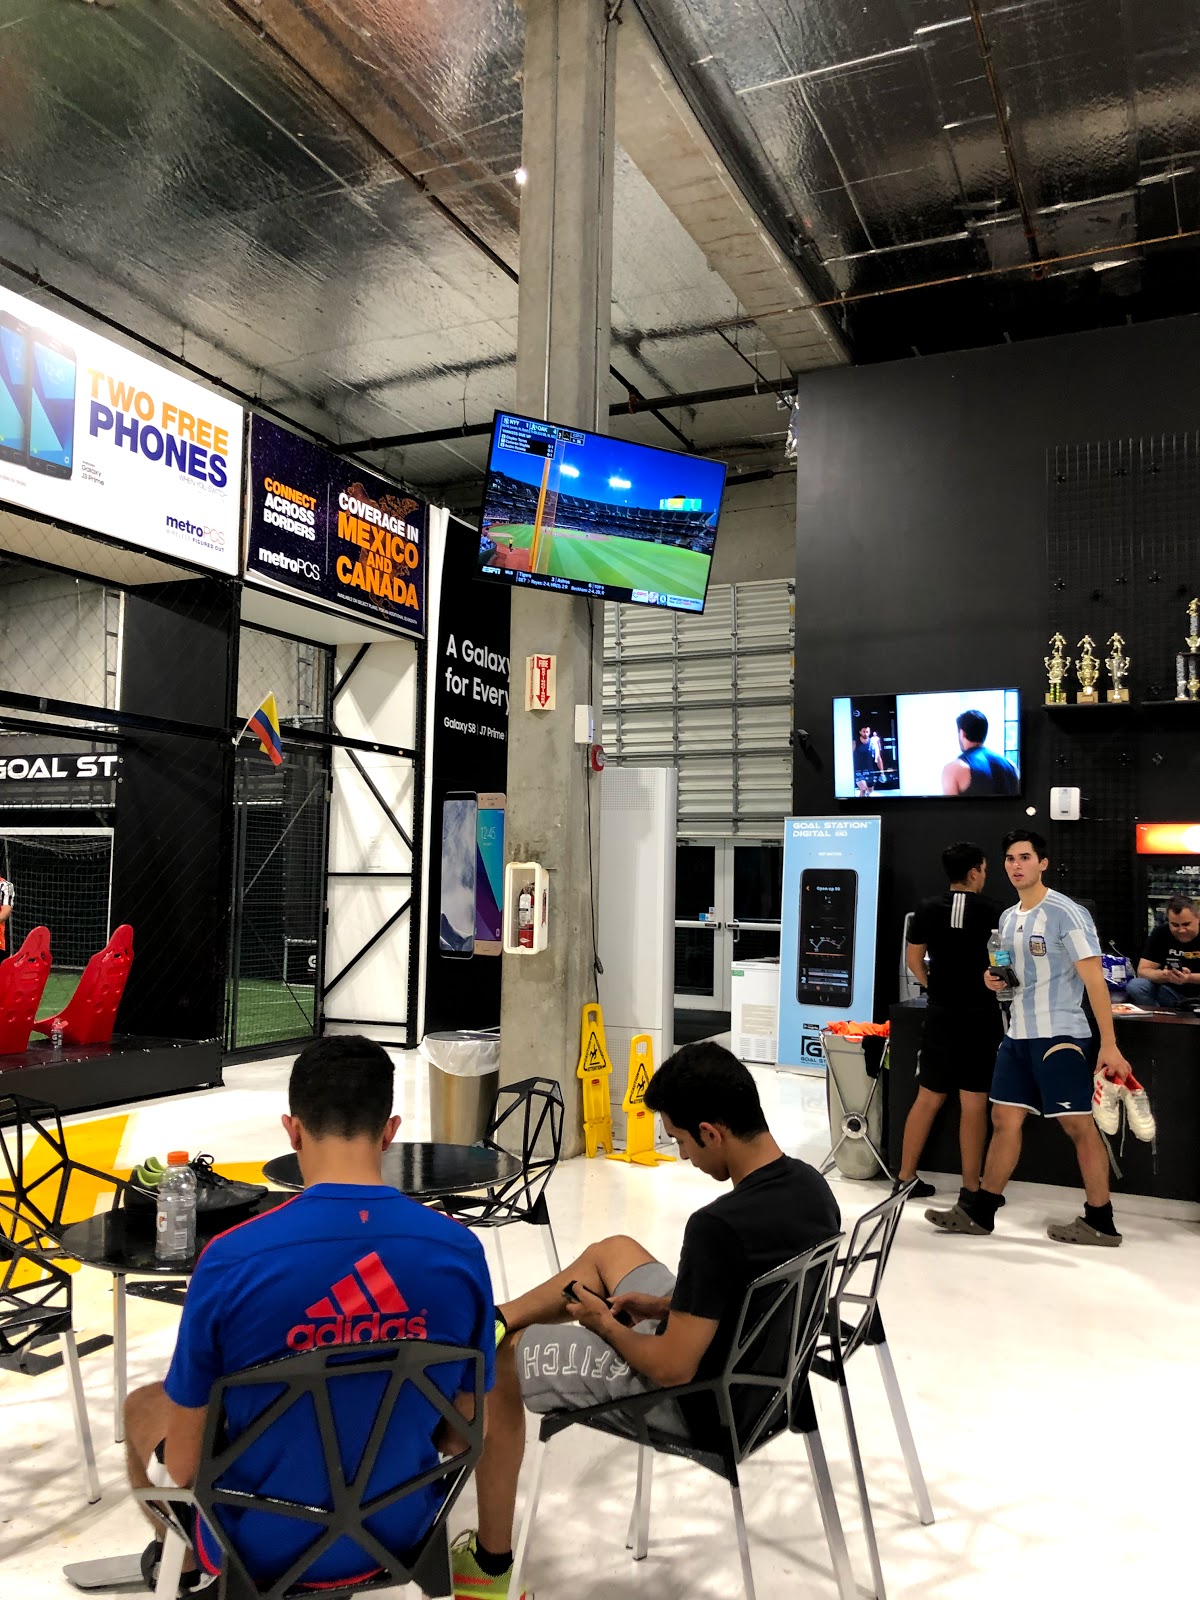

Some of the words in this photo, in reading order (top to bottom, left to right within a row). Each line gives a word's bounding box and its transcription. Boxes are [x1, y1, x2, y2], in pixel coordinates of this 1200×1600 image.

[88, 367, 154, 421] TWO
[162, 401, 228, 456] FREE
[89, 400, 227, 488] PHONES
[81, 464, 102, 477] Galaxy
[88, 475, 104, 486] Prime
[264, 477, 316, 511] CONNECT
[264, 492, 315, 526] ACROSS
[166, 516, 225, 546] metroPCS
[263, 507, 315, 541] BORDERS
[338, 492, 405, 537] COVERAGE
[407, 523, 419, 543] IN
[192, 537, 214, 549] FIGURED
[337, 510, 419, 569] MEXICO
[259, 547, 320, 581] metroPCS
[366, 551, 393, 574] AND
[482, 566, 501, 575] ESPN
[336, 555, 419, 610] CANADA
[446, 633, 458, 658] A
[539, 660, 549, 668] FIRE
[445, 666, 469, 696] for
[443, 716, 468, 734] Galaxy
[468, 722, 476, 734] S8
[479, 725, 486, 736] J7
[487, 727, 505, 740] Prime
[76, 755, 118, 777] ST
[823, 821, 868, 829] STATION
[286, 1311, 428, 1351] adidas
[523, 1343, 611, 1380] FITCH
